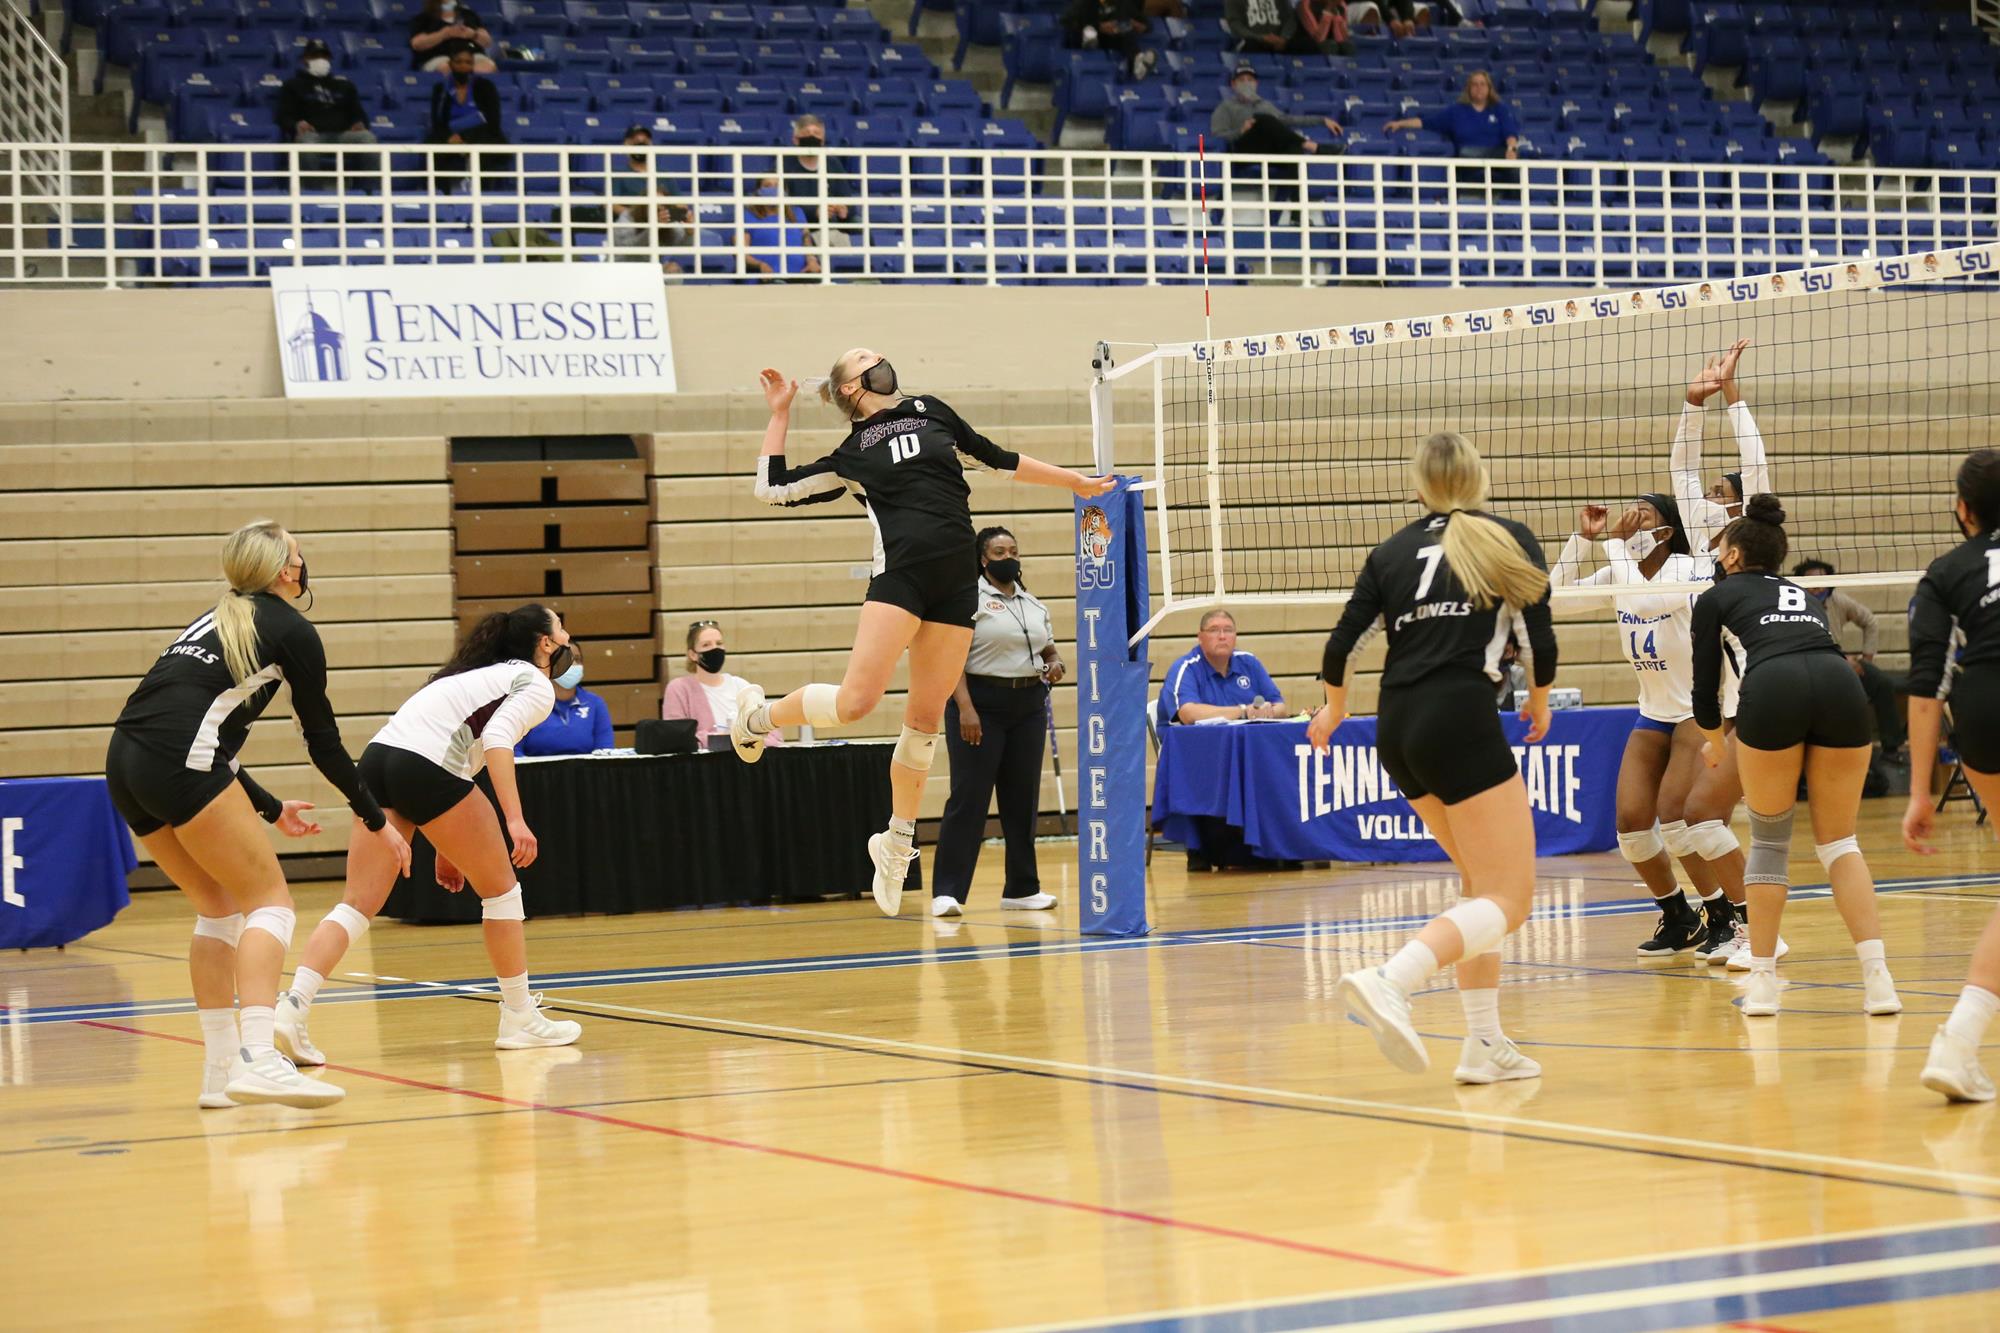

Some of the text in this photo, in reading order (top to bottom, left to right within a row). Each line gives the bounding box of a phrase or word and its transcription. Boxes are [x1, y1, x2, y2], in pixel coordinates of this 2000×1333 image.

[347, 289, 660, 343] TENNESSEE
[365, 345, 667, 381] STATE UNIVERSITY
[860, 418, 928, 452] KENTUCKY
[888, 432, 921, 464] 10
[1414, 544, 1446, 601] 7
[1777, 585, 1807, 612] 8
[1630, 629, 1658, 660] 14
[1633, 660, 1668, 672] STATE
[1083, 607, 1109, 915] TIGERS
